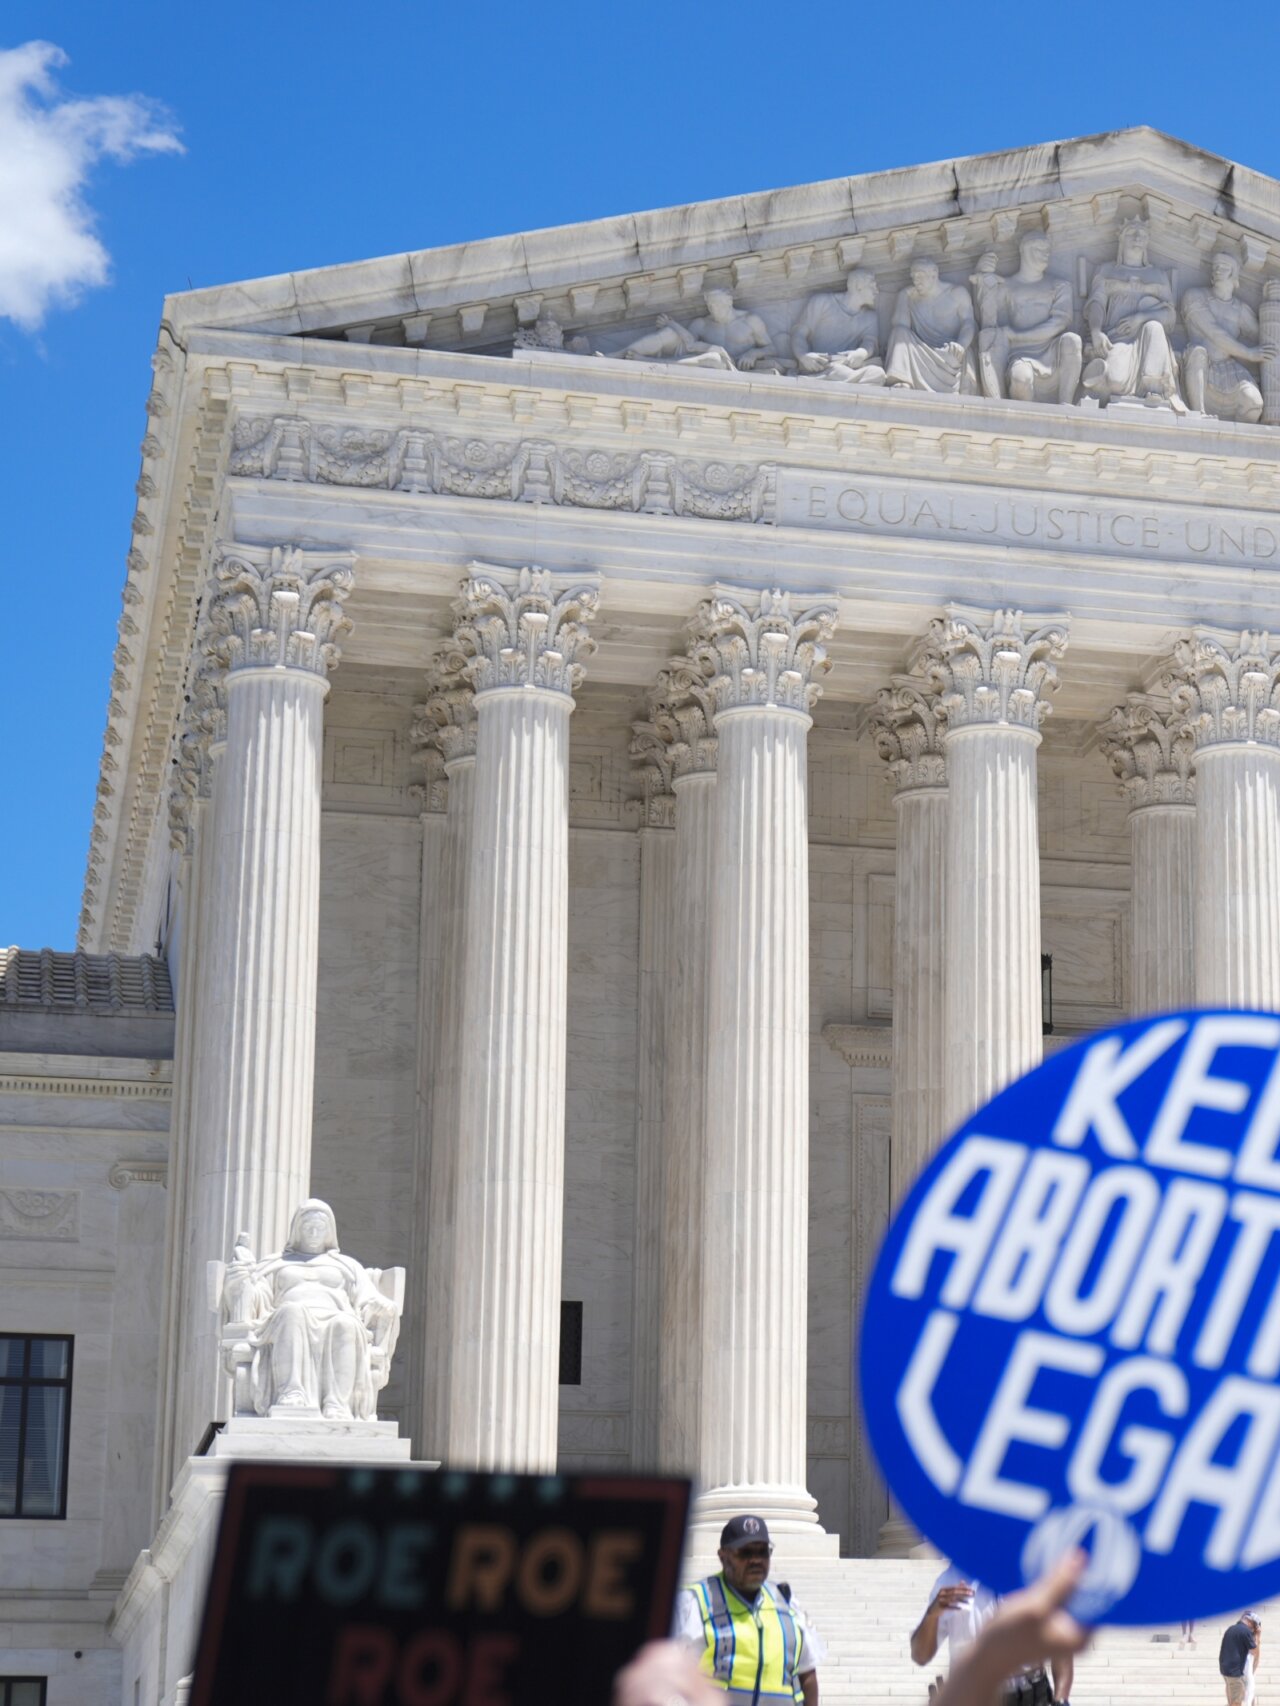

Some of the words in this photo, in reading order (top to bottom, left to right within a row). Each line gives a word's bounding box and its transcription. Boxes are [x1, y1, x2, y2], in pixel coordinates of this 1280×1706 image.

[807, 486, 968, 531] EQUAL
[978, 501, 1160, 549] JUSTICE
[245, 1511, 437, 1608] ROE
[444, 1521, 645, 1621] ROE
[324, 1621, 521, 1706] ROE
